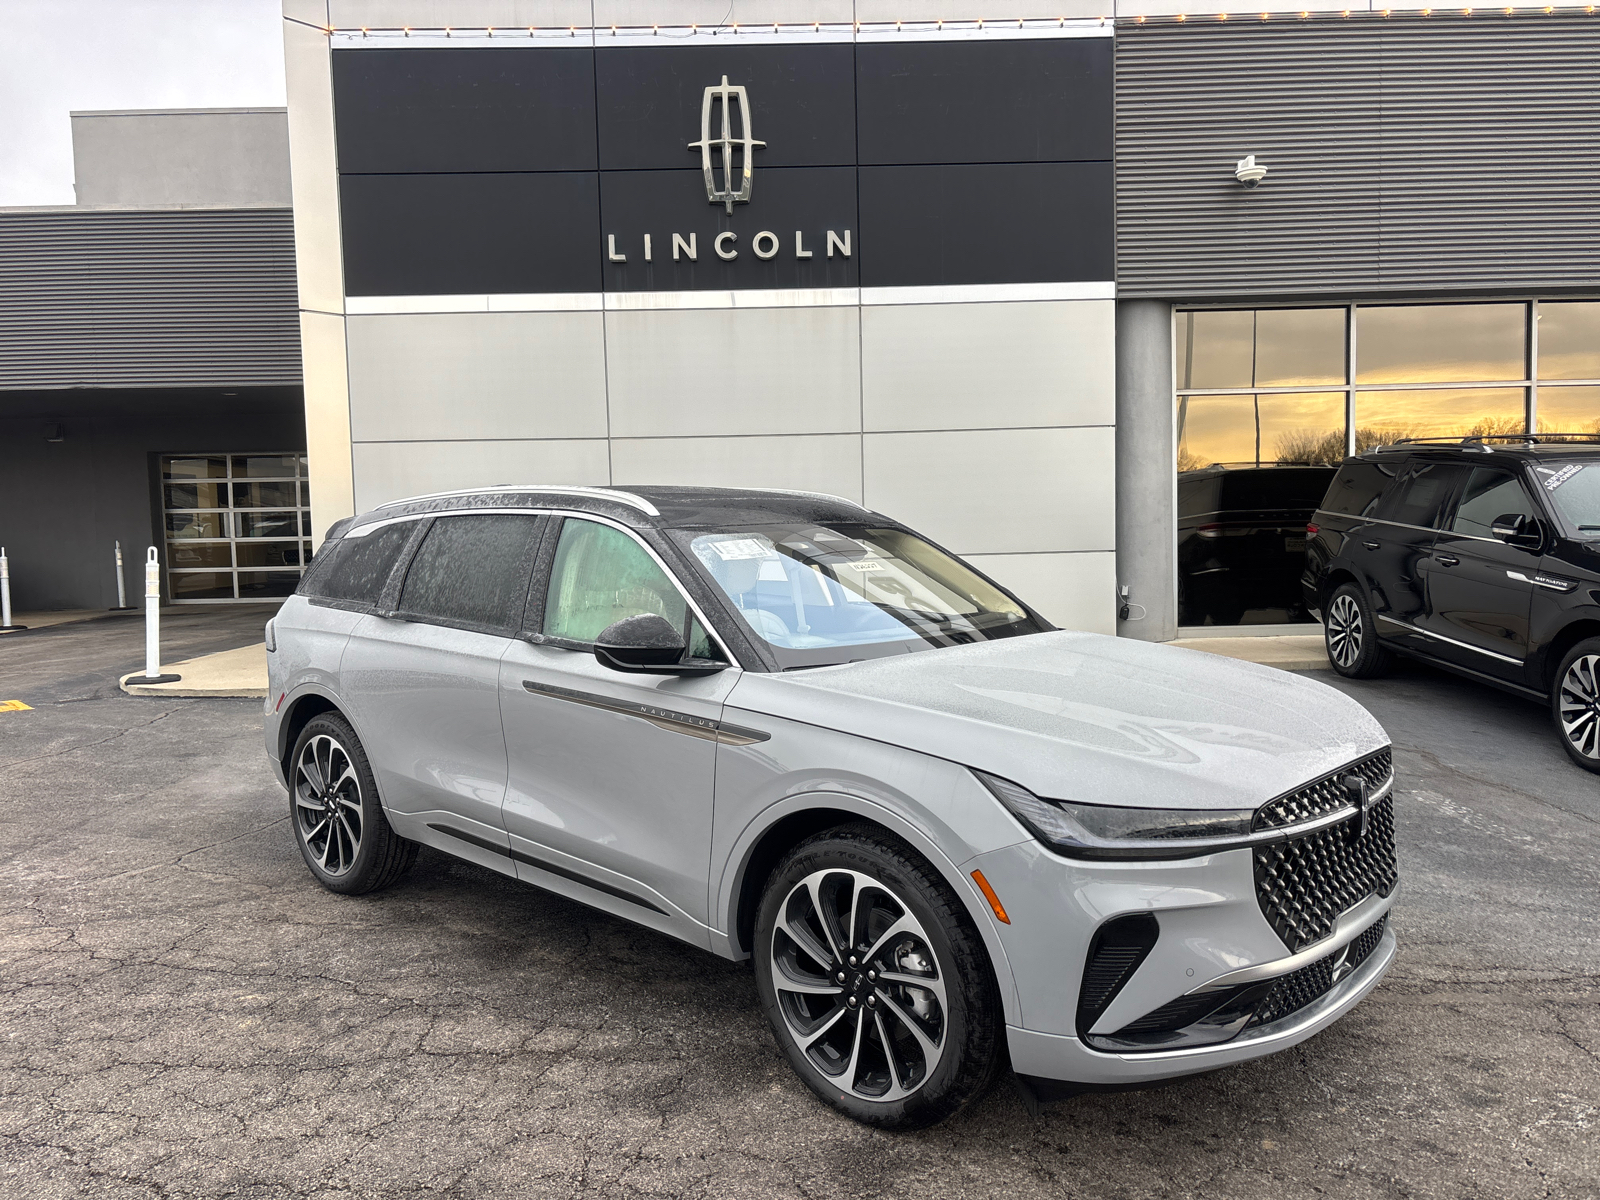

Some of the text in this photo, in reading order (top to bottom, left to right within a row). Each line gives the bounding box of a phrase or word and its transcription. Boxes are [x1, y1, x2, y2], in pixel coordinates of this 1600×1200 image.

[608, 230, 851, 262] LINCOLN
[1544, 464, 1574, 486] CERTIFIED
[1547, 465, 1583, 491] PRE-OWNED
[1534, 576, 1568, 587] NAVIGATOR
[641, 706, 714, 728] NAUTILUS
